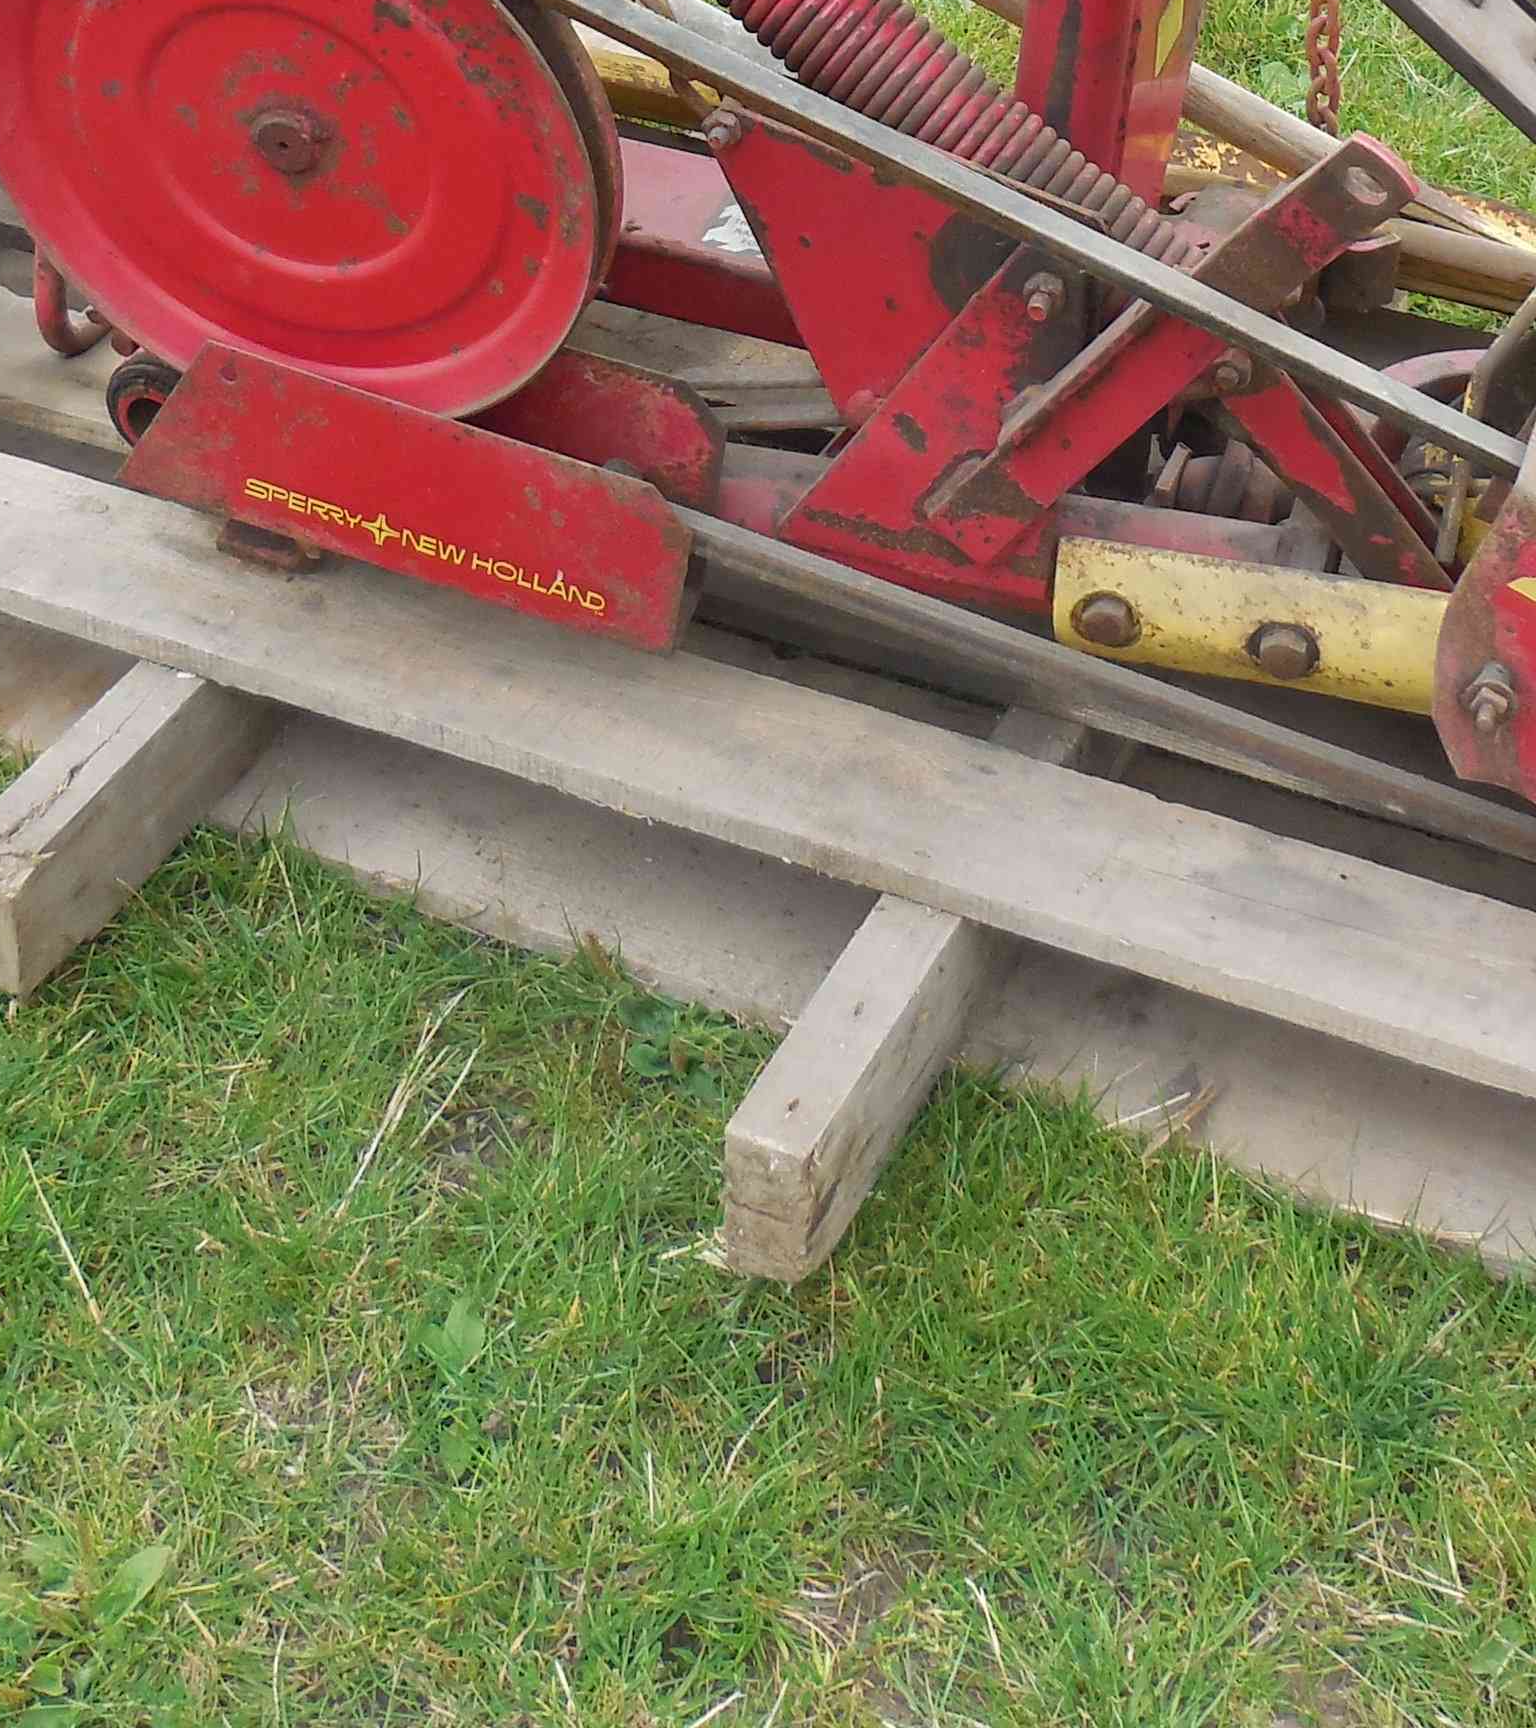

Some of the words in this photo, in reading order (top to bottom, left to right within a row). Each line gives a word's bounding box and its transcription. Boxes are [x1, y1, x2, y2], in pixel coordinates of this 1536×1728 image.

[244, 478, 362, 528] SPERRY
[401, 528, 466, 565] NEW
[471, 552, 606, 611] HOLLAND
